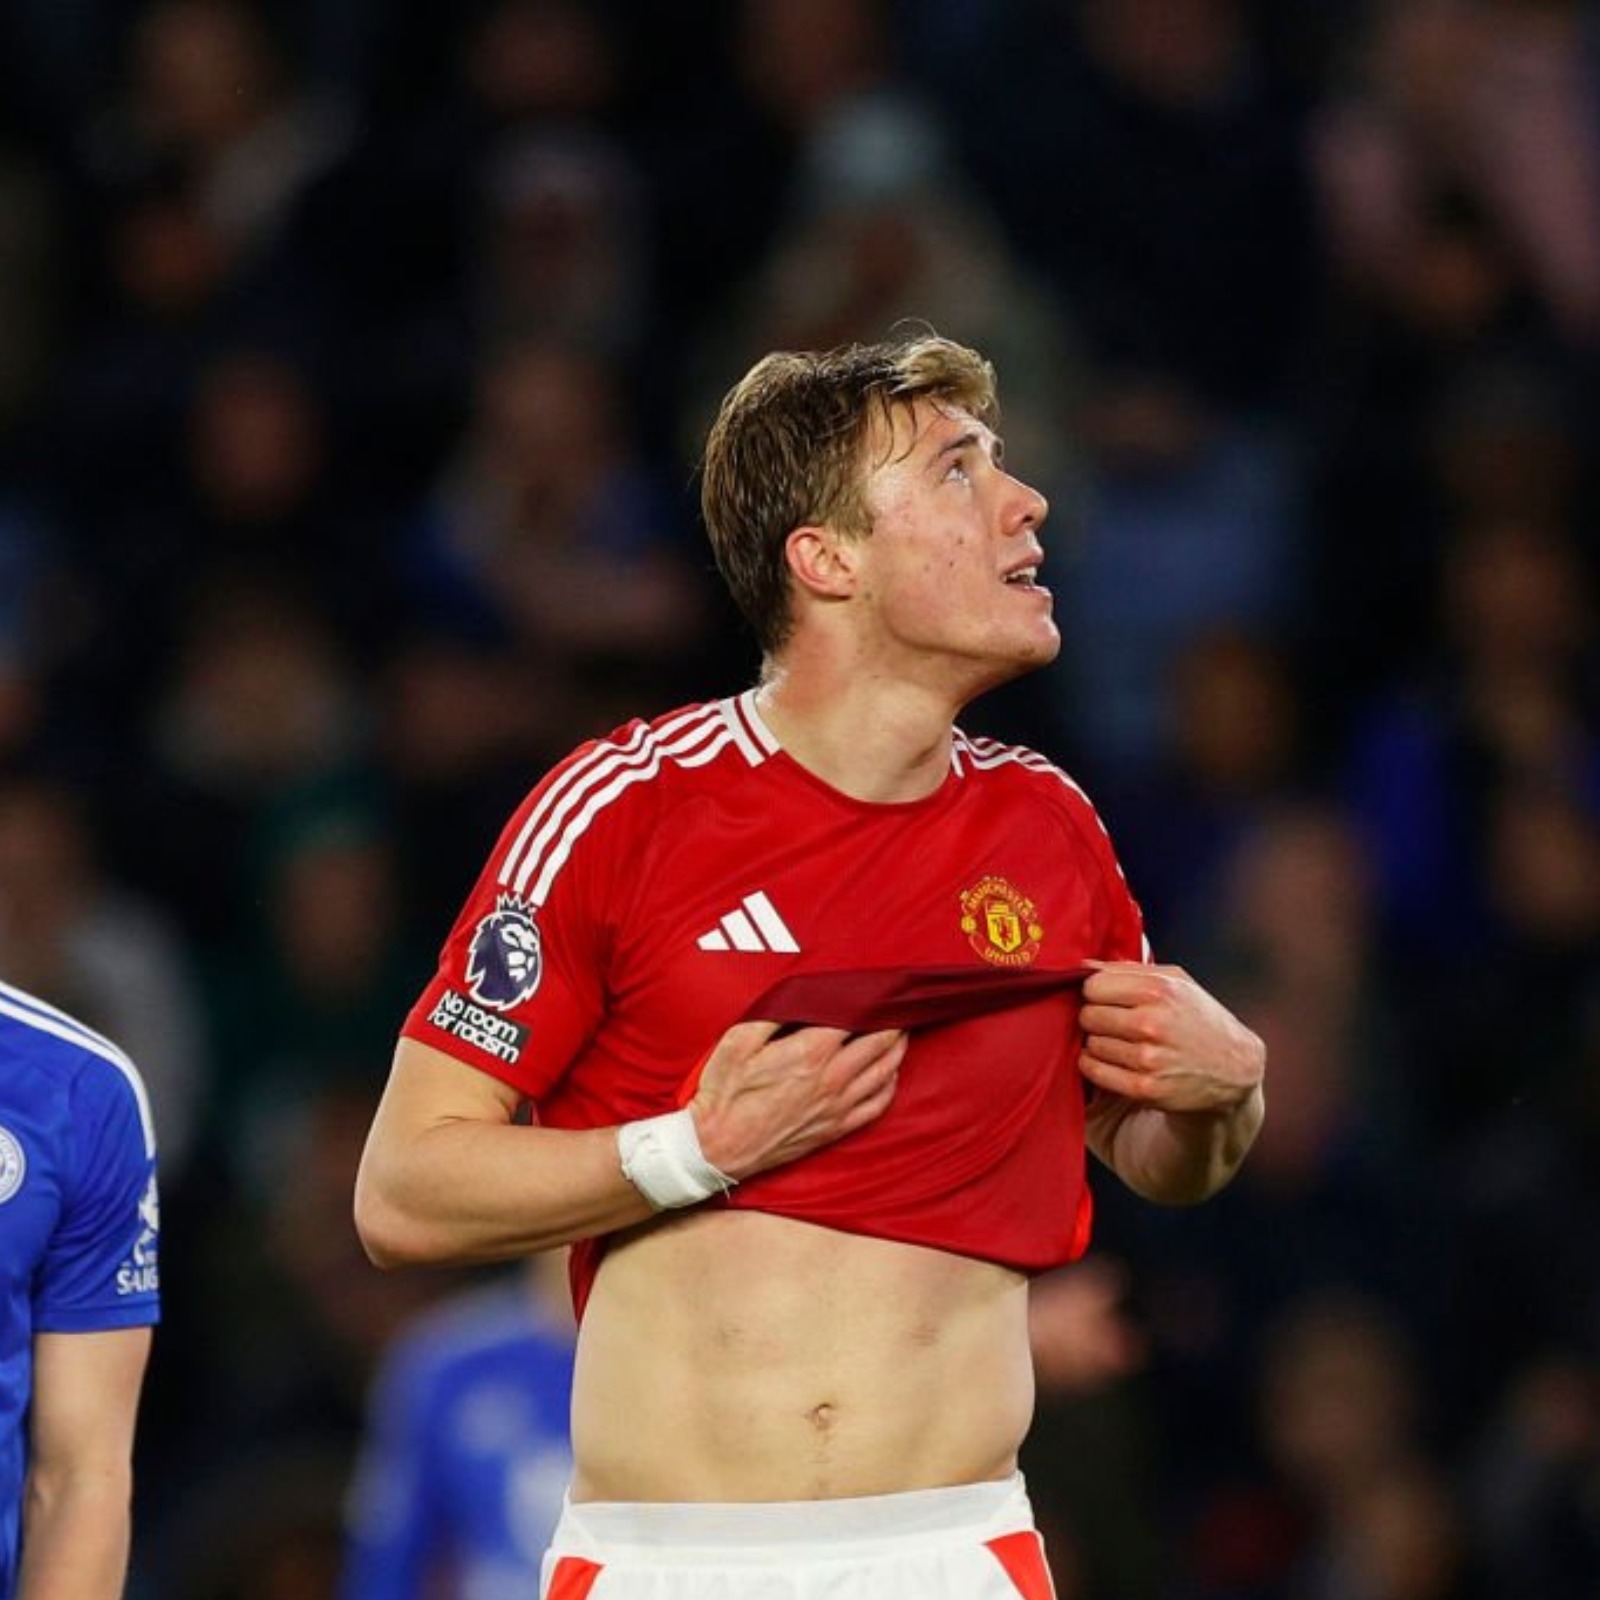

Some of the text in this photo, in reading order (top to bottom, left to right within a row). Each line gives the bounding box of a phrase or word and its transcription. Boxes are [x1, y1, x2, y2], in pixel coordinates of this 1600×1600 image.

[984, 946, 1031, 965] UNITED
[452, 1020, 520, 1065] racism
[462, 1004, 518, 1043] room
